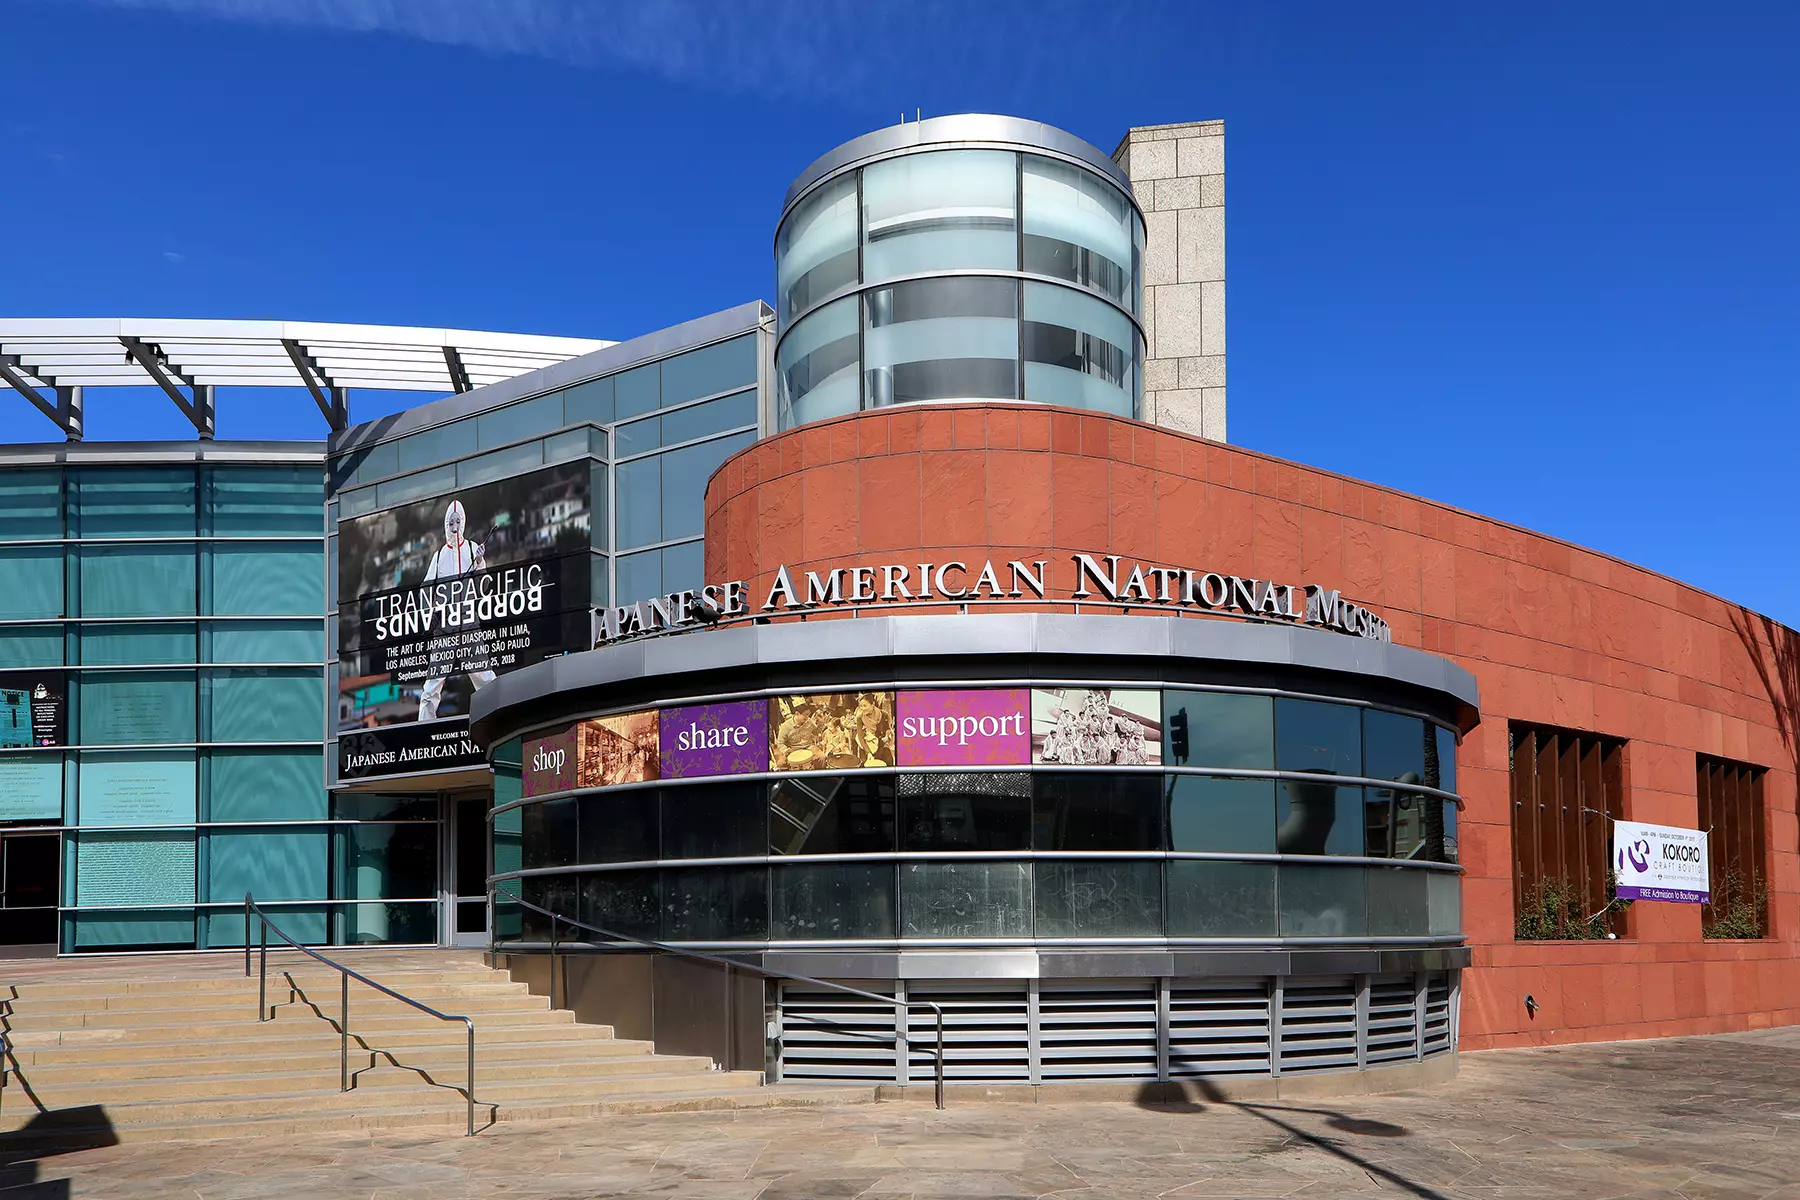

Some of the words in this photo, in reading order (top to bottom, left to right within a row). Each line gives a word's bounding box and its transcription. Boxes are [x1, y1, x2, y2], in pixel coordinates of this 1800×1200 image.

[375, 564, 542, 619] TRANSPACIFIC
[588, 580, 749, 650] JAPANESE
[761, 559, 1047, 610] AMERICAN
[1071, 554, 1302, 619] NATIONAL
[375, 586, 543, 641] BORDERLANDS
[386, 646, 399, 658] THE
[401, 644, 414, 656] ART
[416, 642, 424, 653] OF
[426, 635, 460, 651] JAPANESE
[461, 629, 497, 644] DIASPORA
[499, 628, 508, 638] IN
[510, 623, 531, 637] LIMA,
[386, 659, 398, 671] LOS
[399, 654, 429, 669] ANGELES,
[429, 650, 455, 664] MEXICO
[456, 646, 474, 660] CITY,
[475, 645, 490, 656] AND
[491, 640, 506, 654] SÃO
[507, 637, 531, 651] PAULO
[398, 670, 429, 683] September
[429, 667, 439, 677] 17,
[440, 664, 453, 675] 2017
[461, 659, 489, 673] February
[490, 656, 500, 667] 25,
[501, 654, 516, 665] 2018
[430, 731, 459, 741] WELCOME
[460, 730, 469, 738] TO
[678, 722, 749, 751] share
[903, 710, 1026, 747] support
[344, 751, 396, 772] JAPANESE
[398, 743, 458, 762] AMERICAN
[460, 739, 484, 755] NA
[533, 746, 565, 775] shop
[1653, 861, 1675, 872] CRAFT
[1662, 843, 1700, 863] KOKORO
[1640, 888, 1652, 898] FREE
[1652, 890, 1674, 900] Admission
[1680, 891, 1699, 902] Boutique
